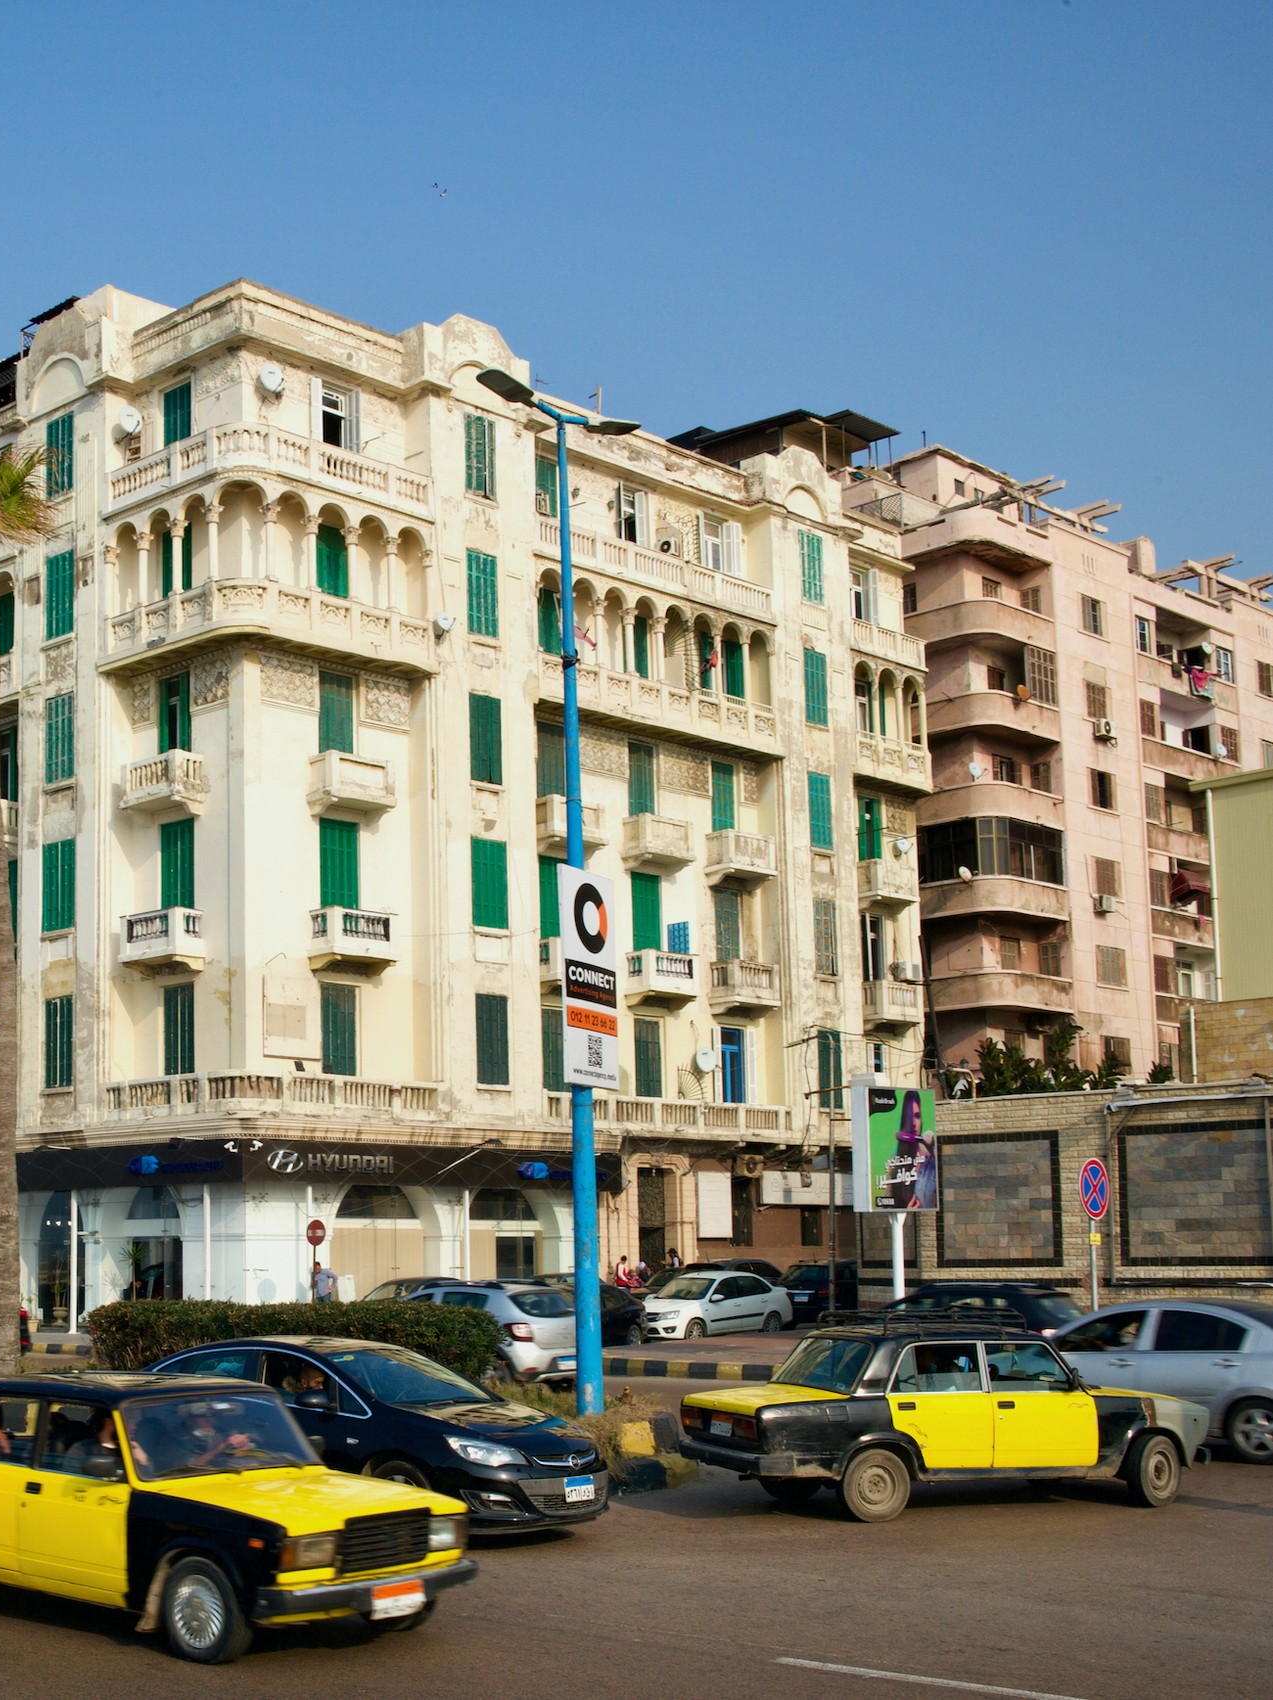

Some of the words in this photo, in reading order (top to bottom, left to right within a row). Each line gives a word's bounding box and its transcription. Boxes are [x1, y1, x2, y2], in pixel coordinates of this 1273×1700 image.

[568, 965, 615, 991] CONNECT
[569, 984, 599, 999] Advertising
[570, 1011, 583, 1023] 012
[584, 1013, 590, 1025] 11
[591, 1015, 599, 1027] 23
[600, 1017, 608, 1029] 66
[608, 1019, 616, 1031] 22
[307, 1153, 395, 1174] HYUNDAI
